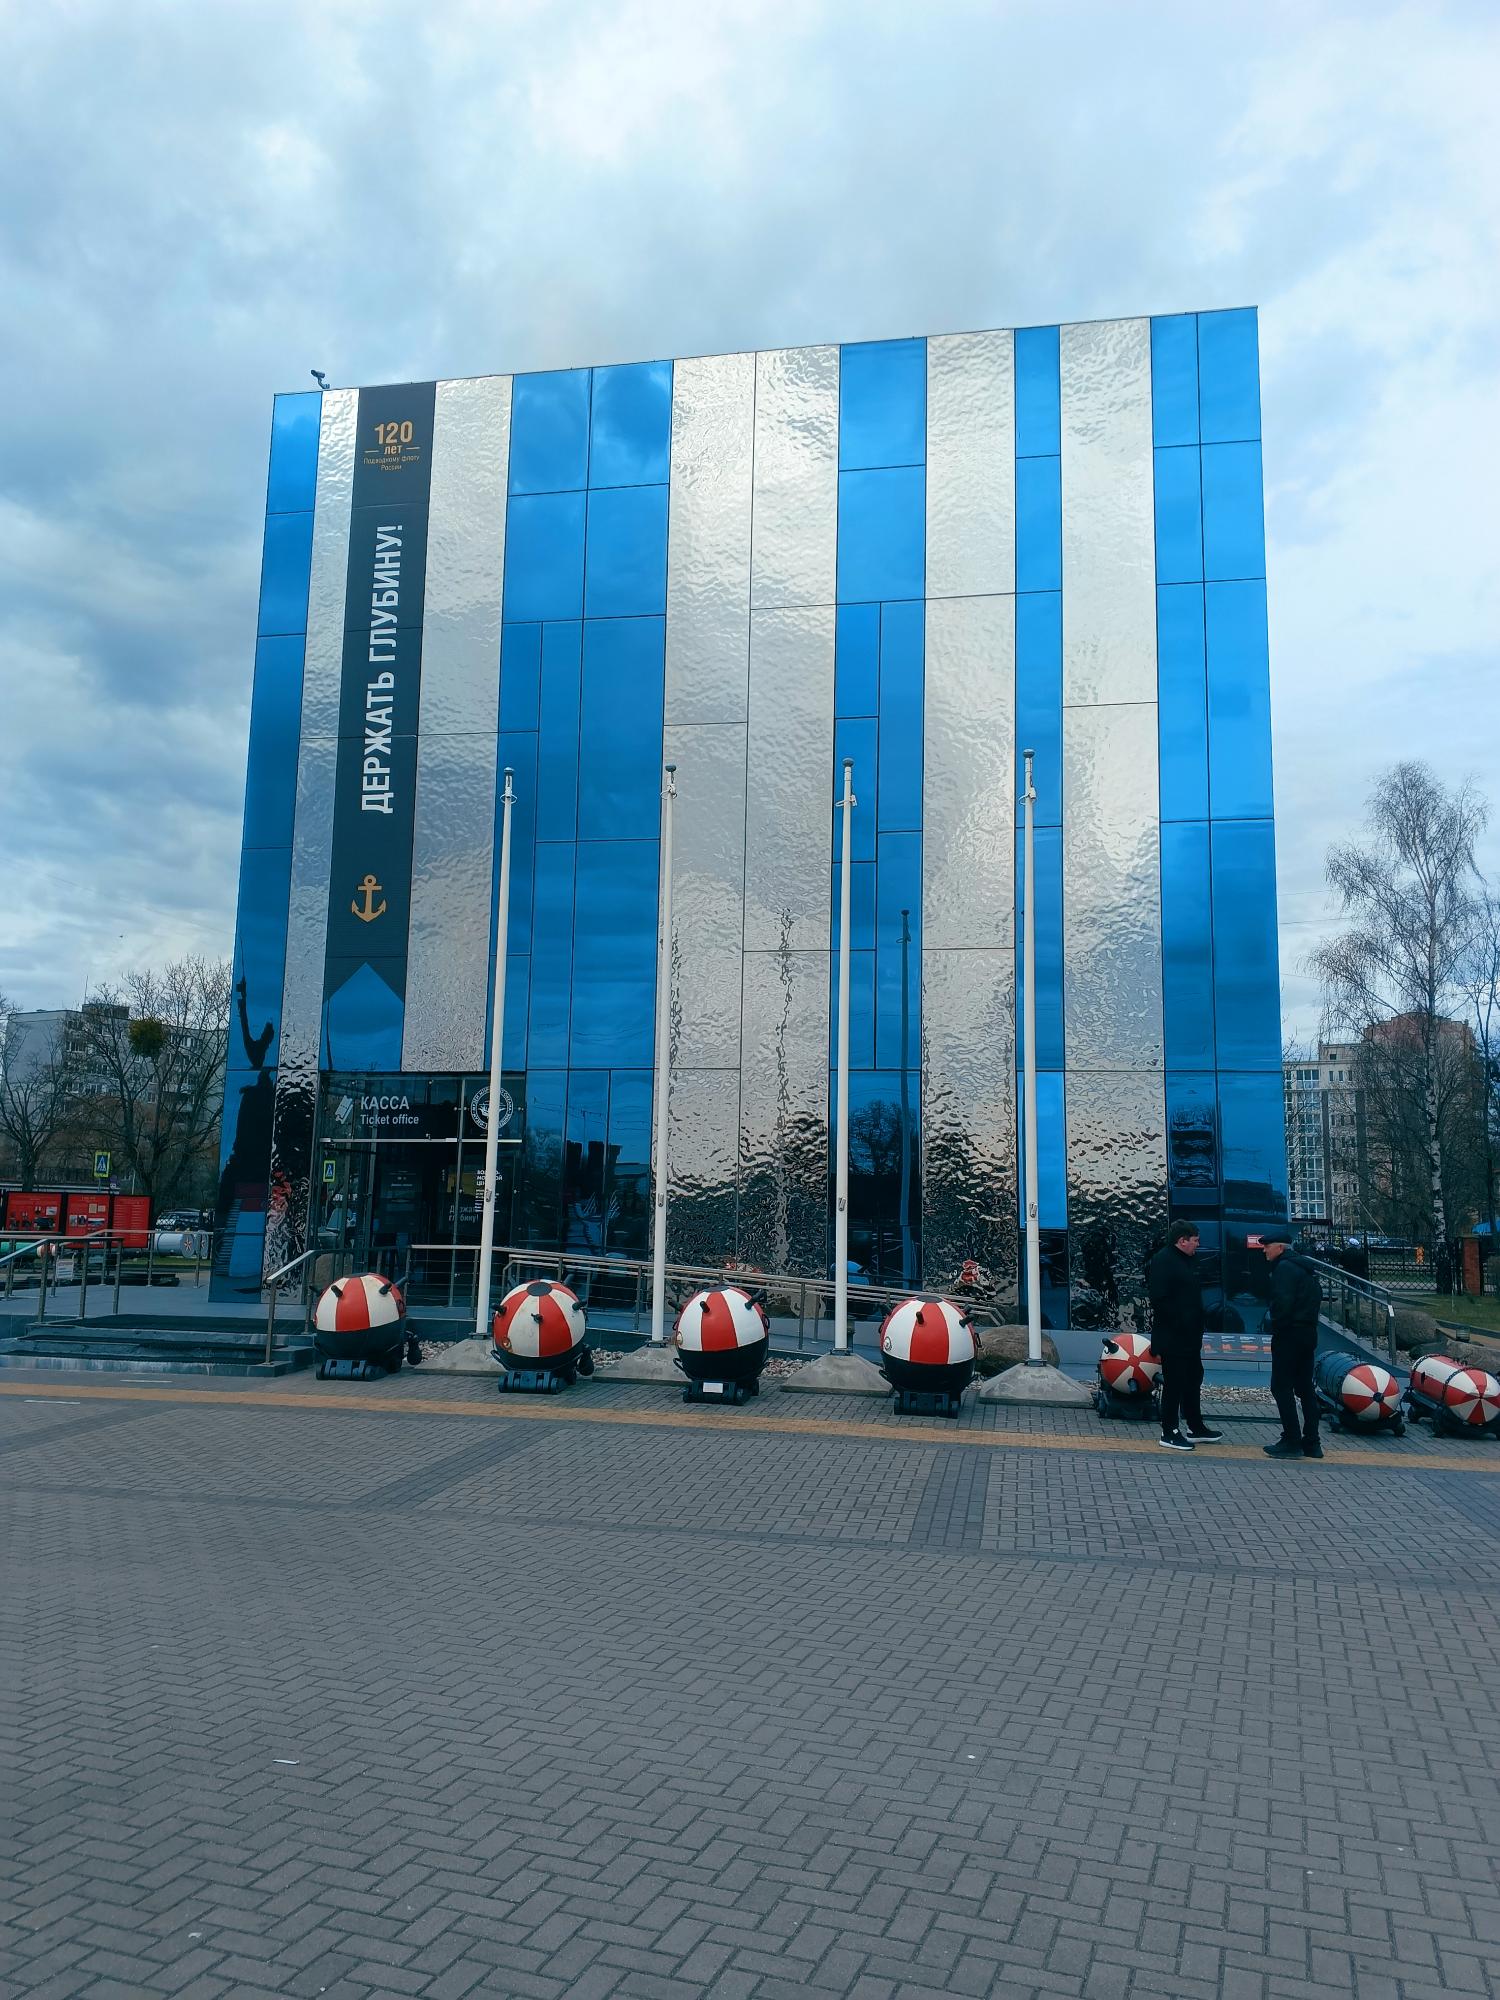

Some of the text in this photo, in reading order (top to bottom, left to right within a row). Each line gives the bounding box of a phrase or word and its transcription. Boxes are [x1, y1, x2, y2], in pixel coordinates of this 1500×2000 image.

[374, 420, 413, 445] 120
[384, 445, 403, 455] лет
[361, 525, 403, 815] ДЕРЖАТЬ ГЛУБИНУ!
[360, 1095, 410, 1110] КАССА
[360, 1113, 420, 1125] Ticket office
